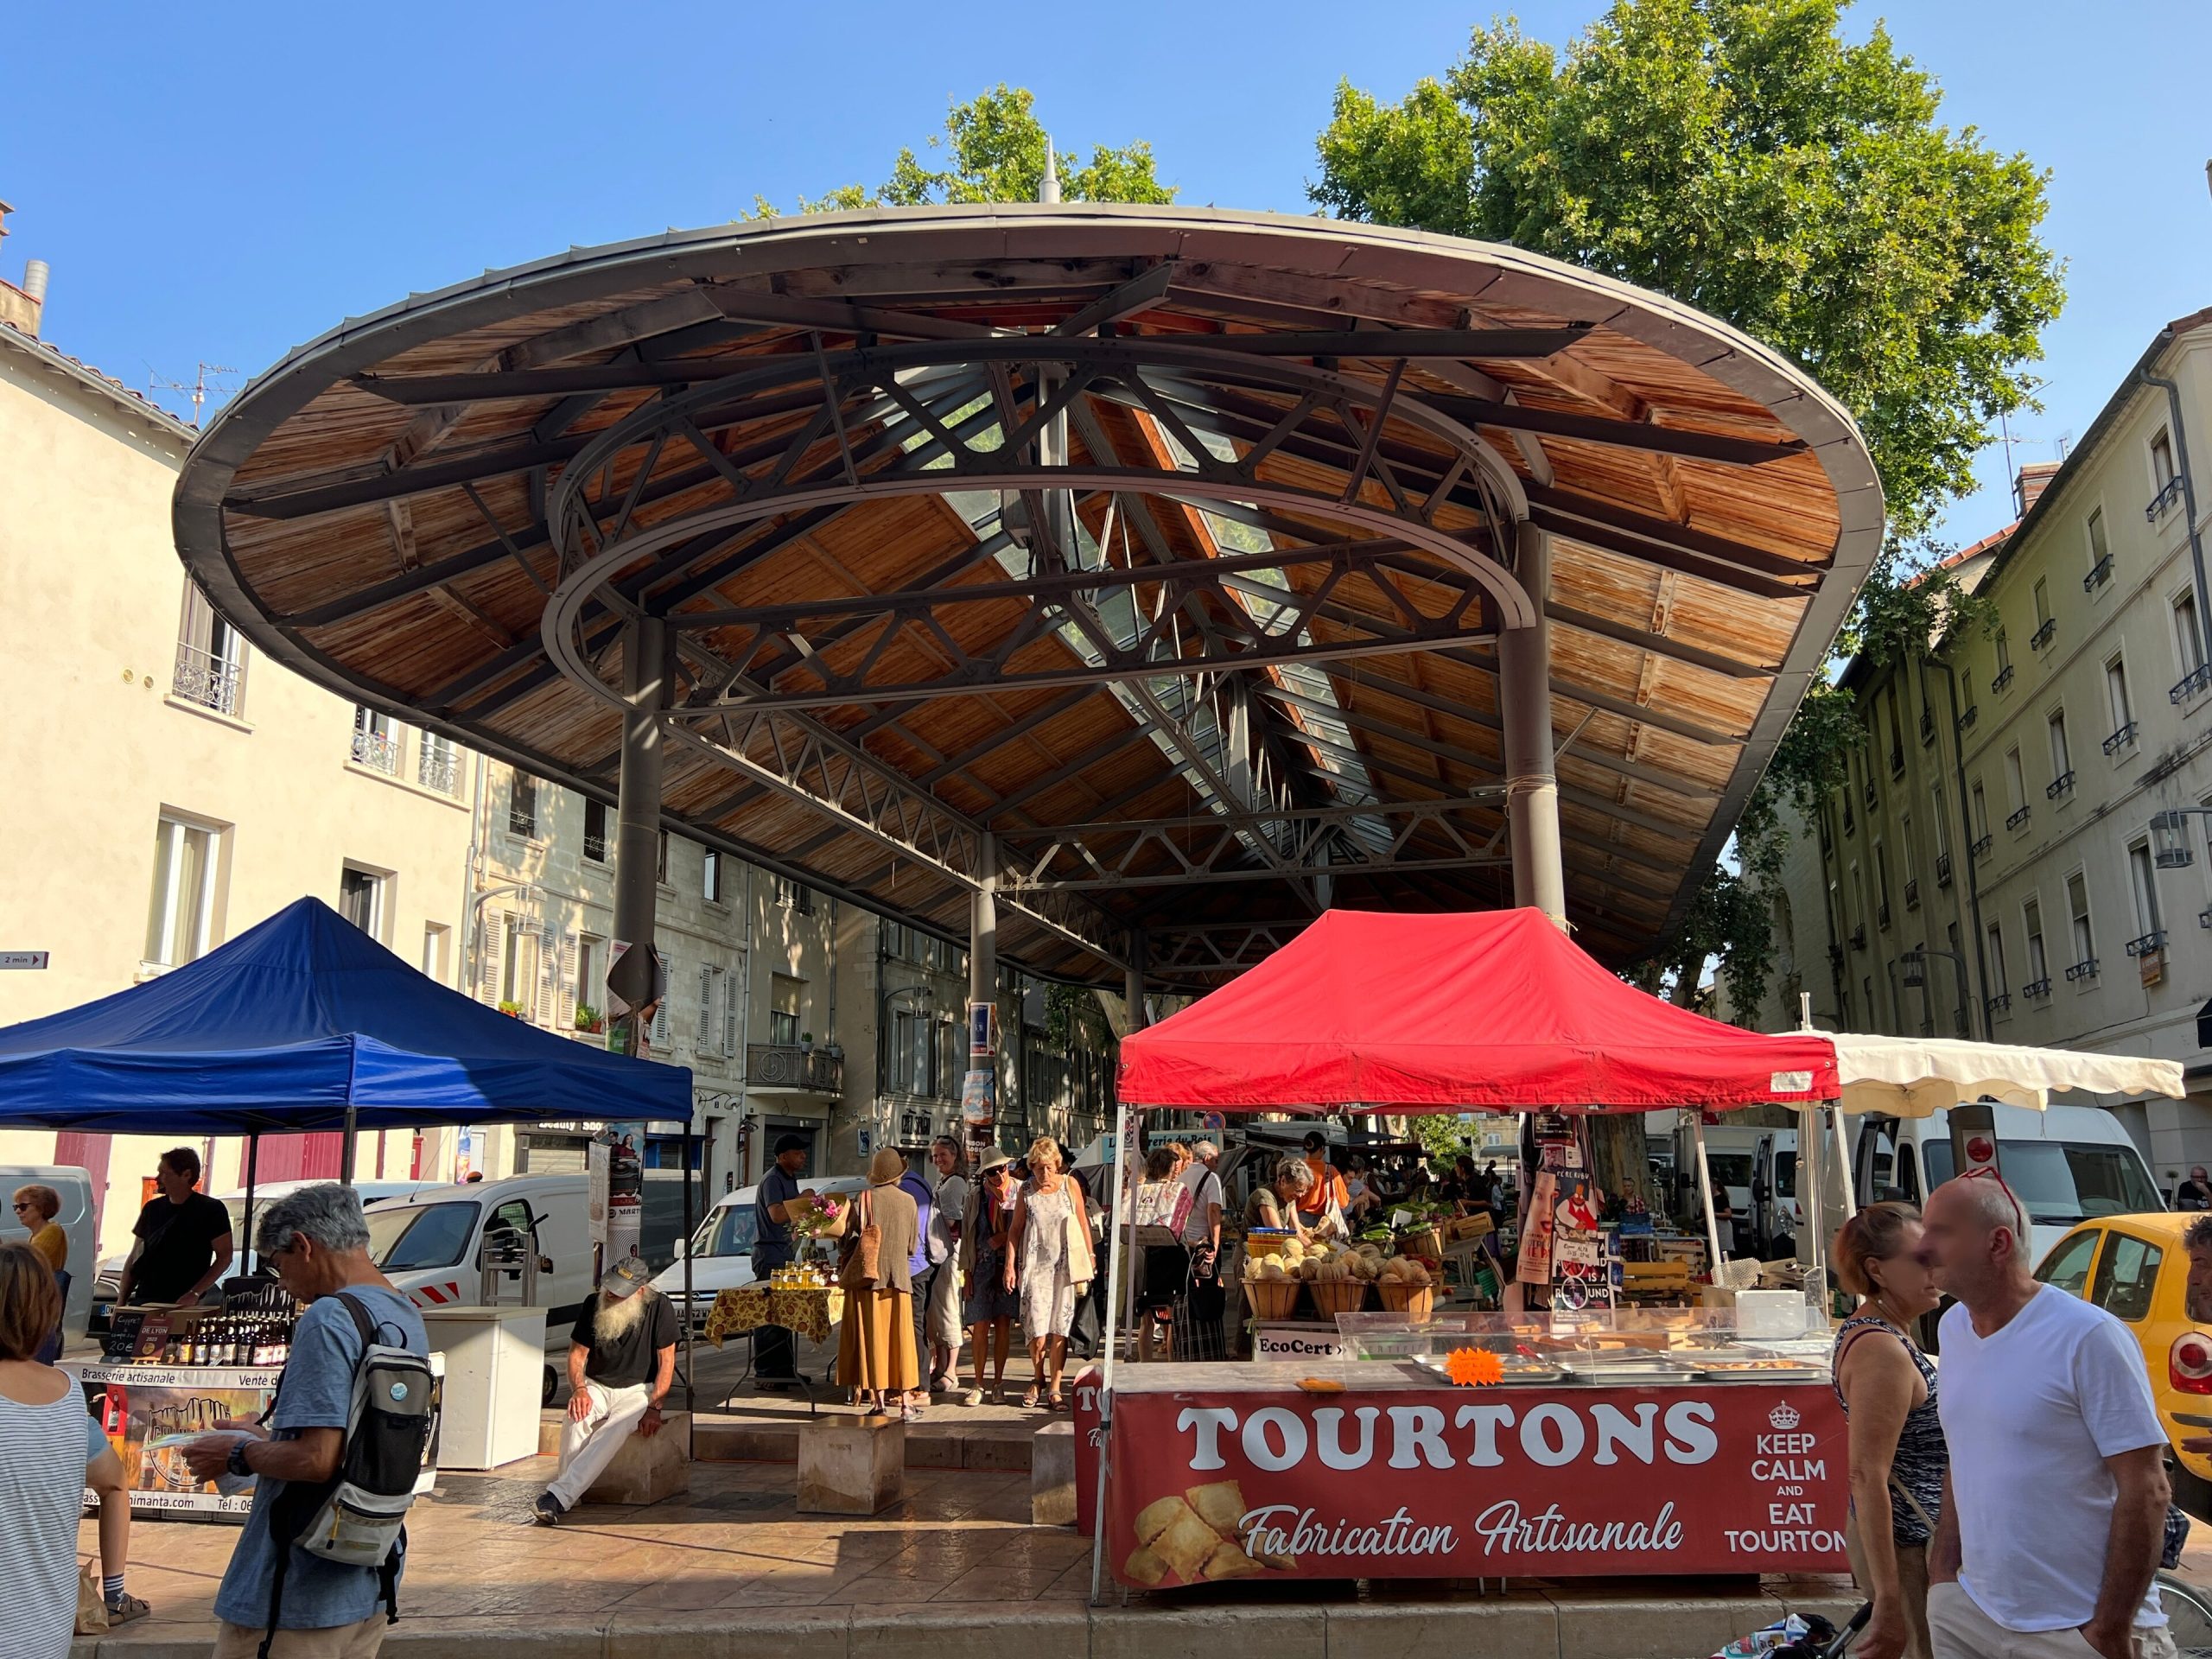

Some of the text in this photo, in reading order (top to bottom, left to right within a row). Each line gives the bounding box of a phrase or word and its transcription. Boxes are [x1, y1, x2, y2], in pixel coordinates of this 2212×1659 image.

[582, 1122, 604, 1131] Sho
[1588, 1272, 1607, 1282] IS A
[1259, 1338, 1332, 1355] EcoCert
[82, 1369, 278, 1386] Brasserie artisanale Vente d
[1177, 1402, 1718, 1471] TOURTONS
[1757, 1433, 1815, 1454] KEEP
[1751, 1459, 1826, 1481] CALM
[1777, 1485, 1803, 1496] AND
[218, 1498, 232, 1510] Tél
[240, 1500, 252, 1511] 06
[1769, 1503, 1816, 1525] EAT
[1238, 1500, 1685, 1557] Fabrication Artisanale
[1724, 1530, 1847, 1553] TOURTON
